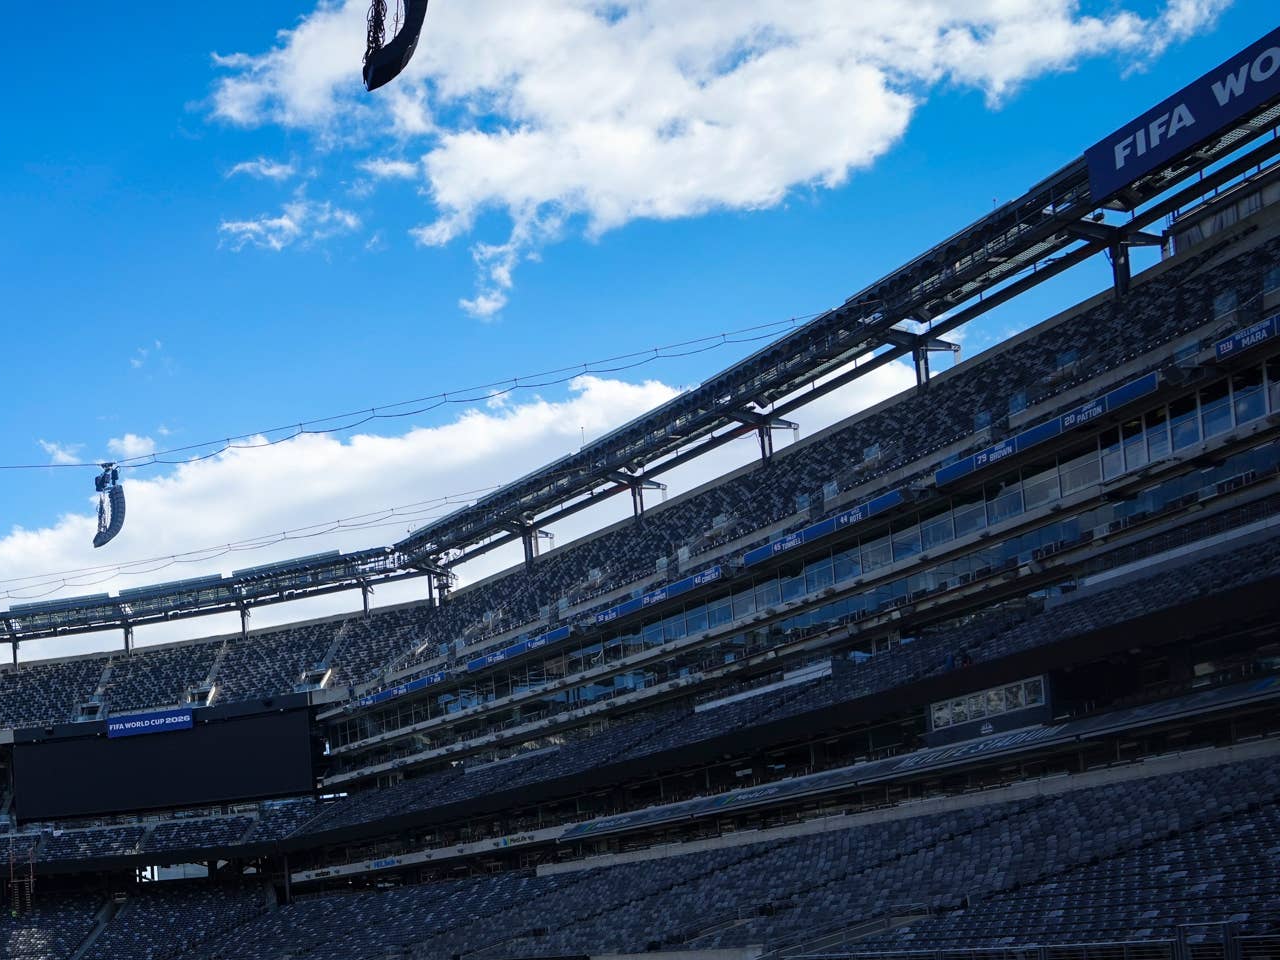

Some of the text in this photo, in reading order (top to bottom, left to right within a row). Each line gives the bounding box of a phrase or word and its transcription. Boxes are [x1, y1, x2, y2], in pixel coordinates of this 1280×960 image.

[1114, 46, 1280, 171] FIFA WO
[1241, 329, 1268, 347] MARA
[1064, 405, 1102, 426] 20 PATTON
[976, 453, 987, 464] 79
[989, 446, 1012, 462] BROWN
[109, 715, 191, 731] FIFA WORLD CUP 2026
